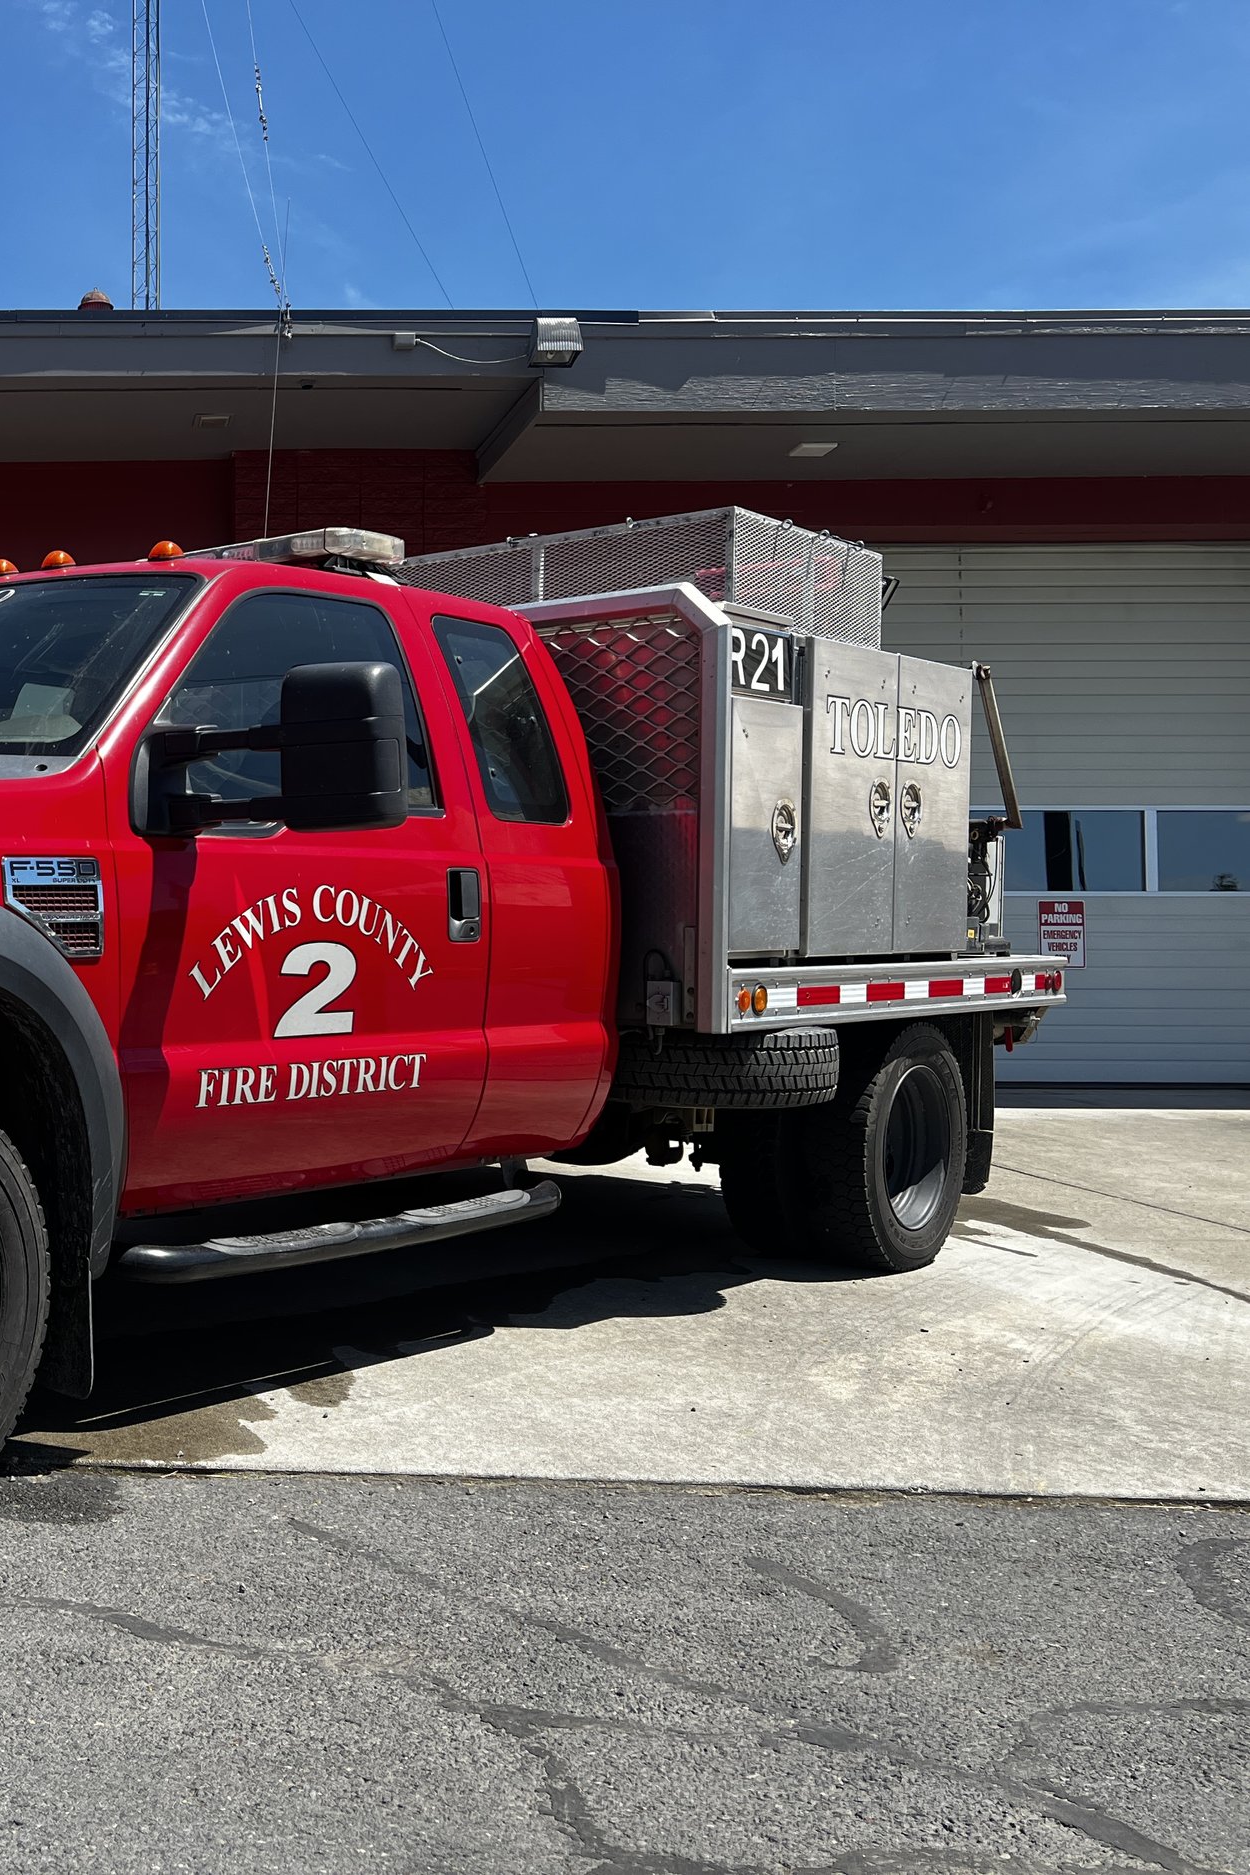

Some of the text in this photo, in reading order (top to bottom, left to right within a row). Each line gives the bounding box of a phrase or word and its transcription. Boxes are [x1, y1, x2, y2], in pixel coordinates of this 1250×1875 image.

[826, 694, 962, 769] TOLEDO
[1041, 913, 1083, 924] PARKING
[1054, 903, 1069, 912] NO
[188, 884, 434, 1001] LEWIS COUNTY
[1043, 930, 1082, 939] EMERGENCY
[1048, 942, 1078, 951] VEHICLES
[273, 941, 358, 1039] 2
[196, 1053, 427, 1109] FIRE DISTRICT
